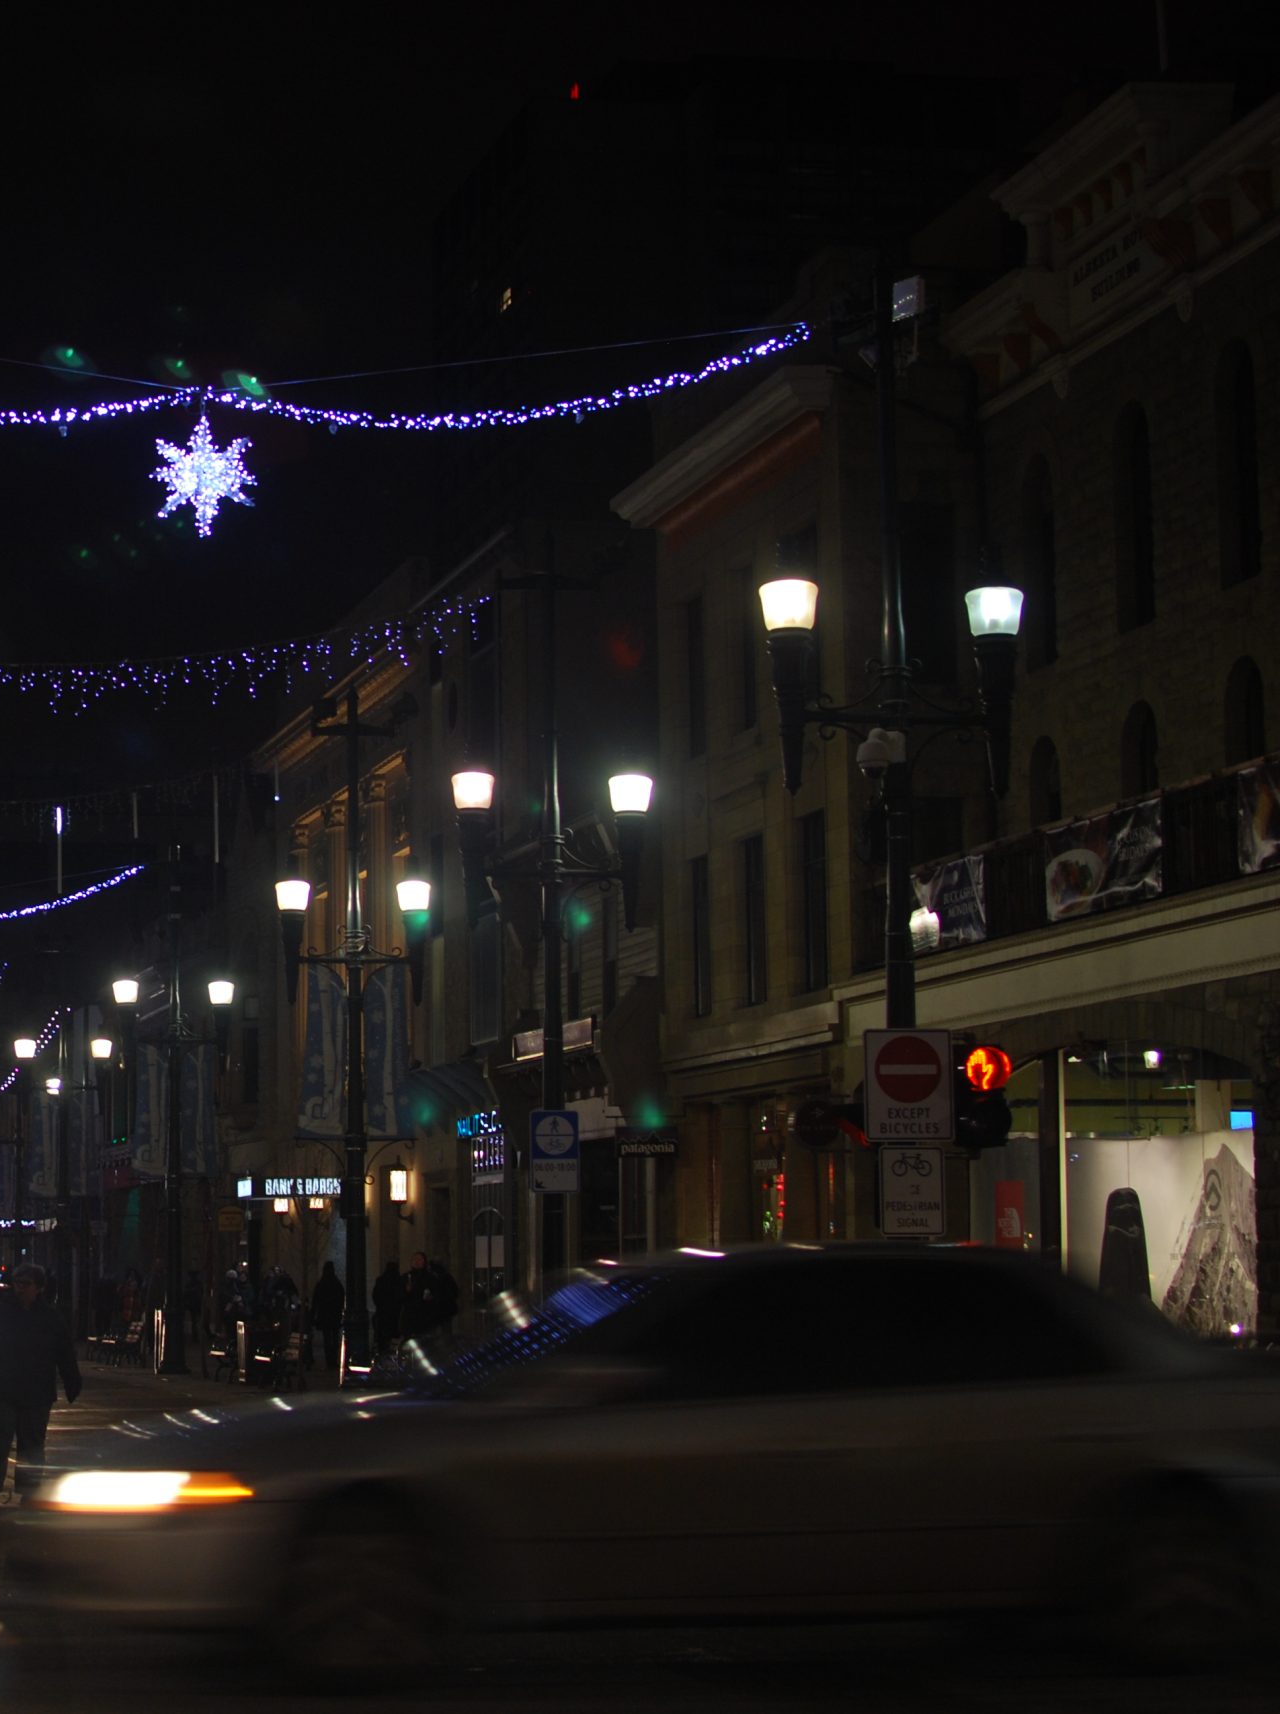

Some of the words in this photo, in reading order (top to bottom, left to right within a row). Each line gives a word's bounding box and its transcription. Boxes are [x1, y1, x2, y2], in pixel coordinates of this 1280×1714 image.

[1090, 256, 1141, 303] BUILDING
[887, 1107, 930, 1120] EXCEPT
[879, 1123, 940, 1134] BICYCLES
[620, 1143, 676, 1155] patagonia
[885, 1201, 940, 1211] PEDESTRIAN
[896, 1217, 930, 1228] SIGNAL
